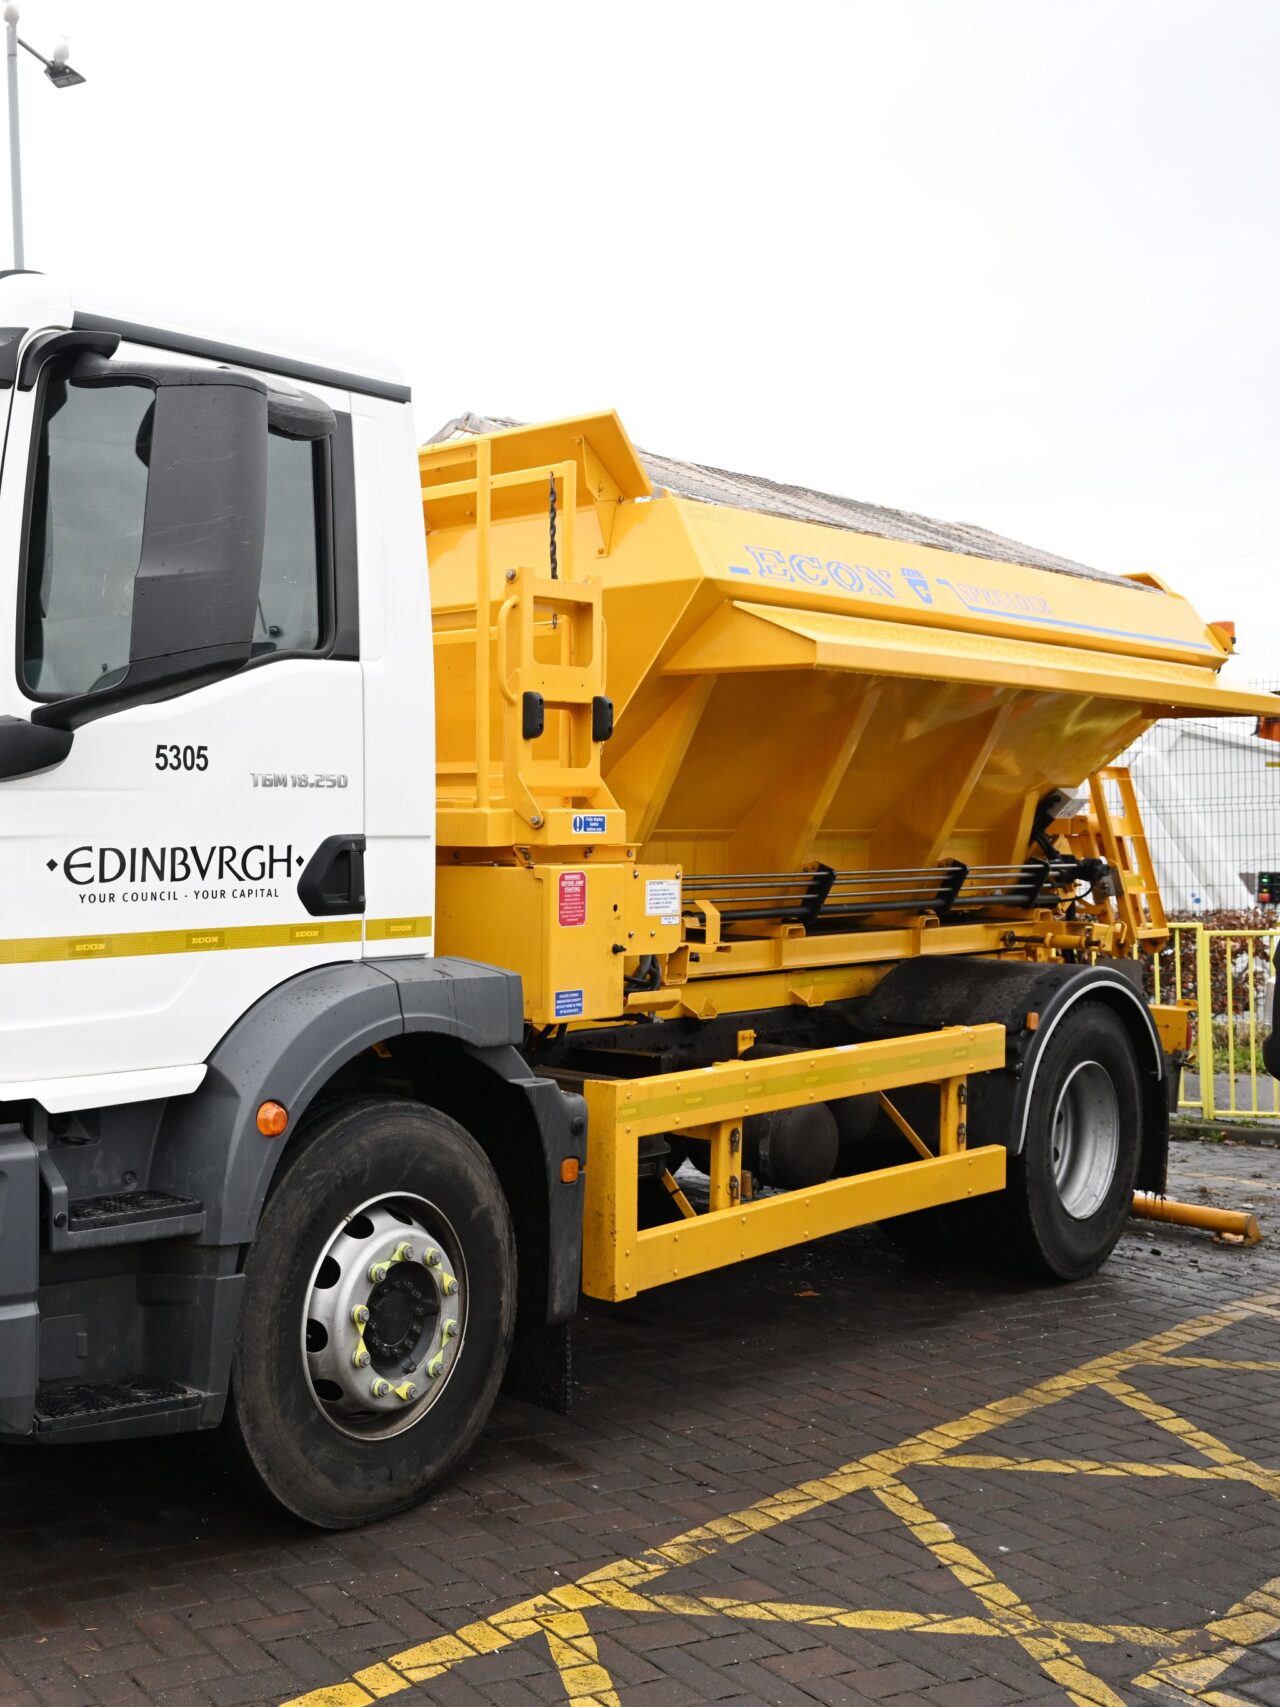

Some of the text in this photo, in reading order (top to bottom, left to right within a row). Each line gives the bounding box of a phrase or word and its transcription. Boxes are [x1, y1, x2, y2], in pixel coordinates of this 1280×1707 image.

[744, 544, 901, 599] ECON
[956, 582, 1052, 614] SPREADER
[154, 744, 209, 772] 5305
[250, 771, 348, 788] TGM 18.250
[63, 844, 292, 885] EDINBVRGH
[79, 892, 116, 904] YOUR
[122, 890, 179, 903] COUNCIL
[193, 888, 226, 900] YOUR
[231, 887, 279, 899] CAPITAL
